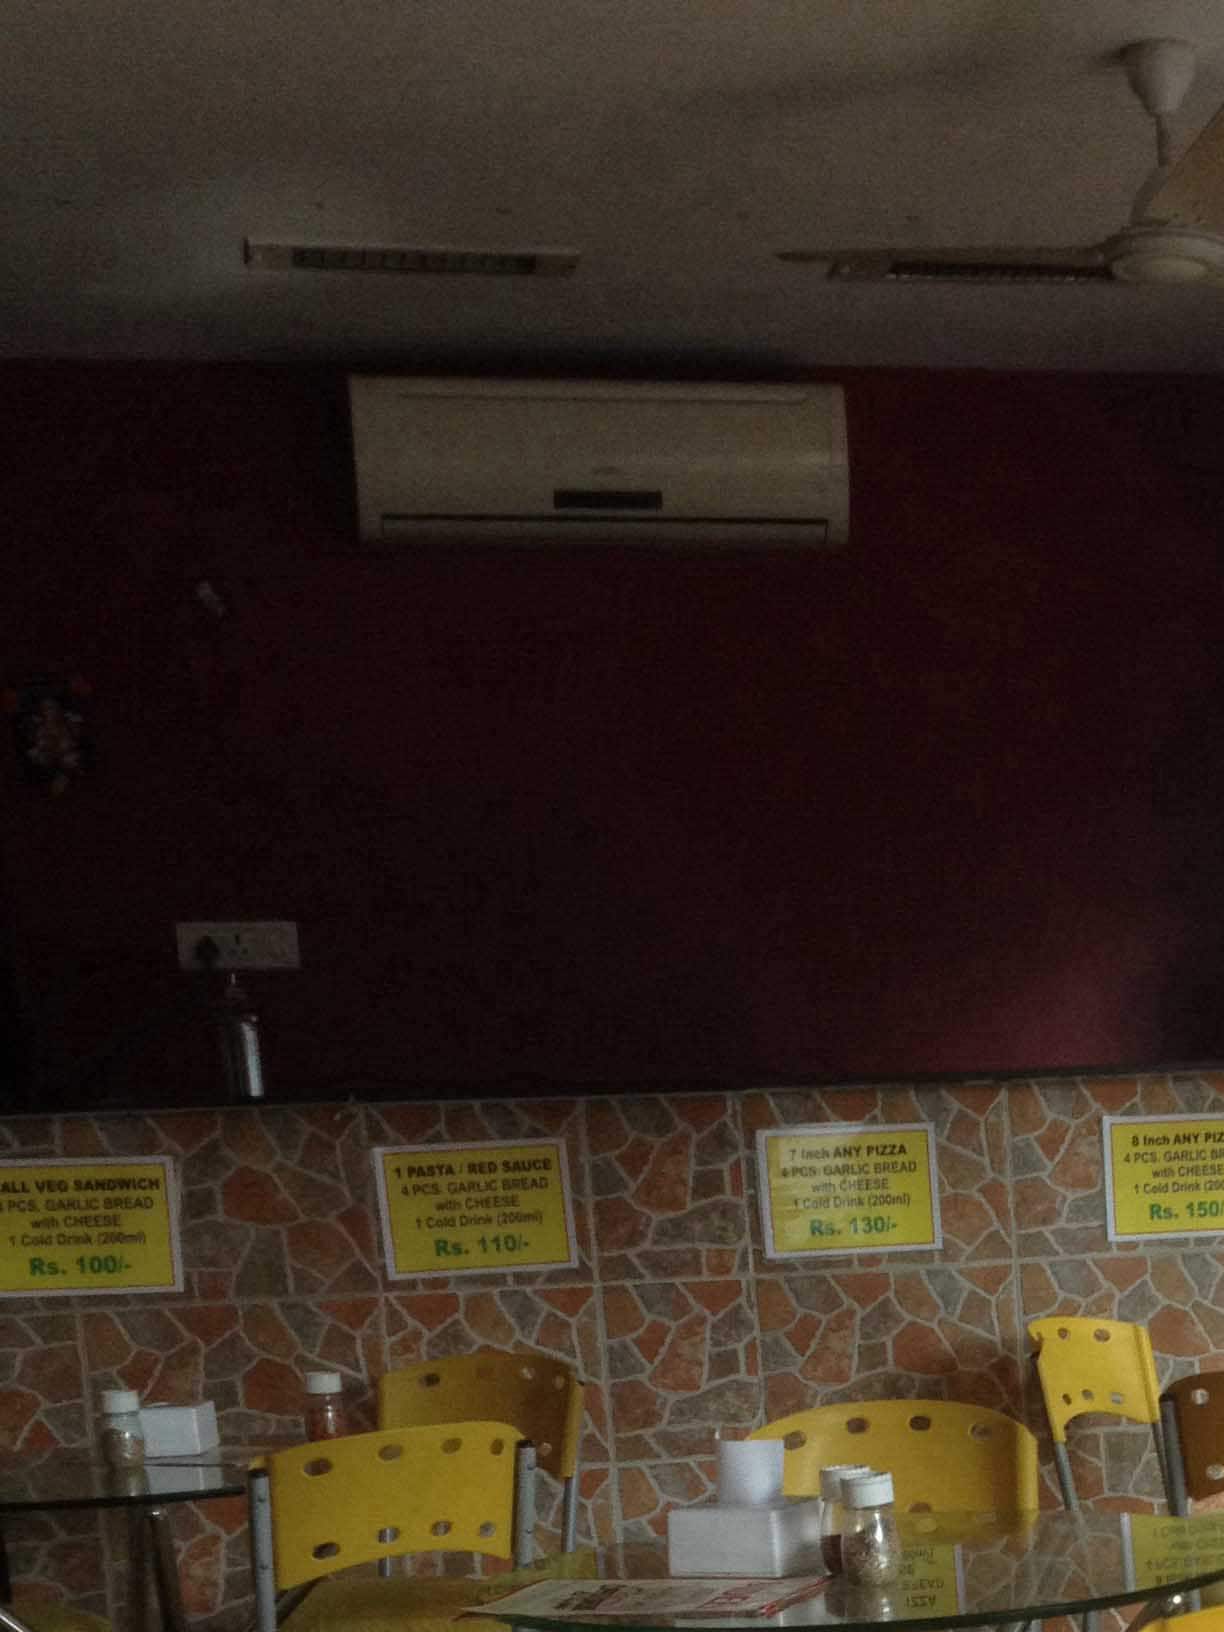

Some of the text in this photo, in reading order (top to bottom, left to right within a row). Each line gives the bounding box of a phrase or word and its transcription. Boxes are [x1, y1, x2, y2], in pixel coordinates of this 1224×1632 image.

[1172, 1132, 1200, 1144] ANY
[833, 1145, 862, 1158] ANY
[867, 1144, 907, 1157] PIZZA
[1163, 1149, 1207, 1162] GARLIC
[408, 1165, 455, 1178] PASTA
[468, 1161, 497, 1175] RED
[503, 1158, 552, 1172] SAUCE
[823, 1163, 869, 1175] GARLIC
[874, 1161, 917, 1174] BREAD
[1152, 1164, 1224, 1178] with CHEESE
[73, 1178, 160, 1191] SANDWICH
[448, 1180, 498, 1195] GARLIC
[502, 1177, 549, 1191] BREAD
[811, 1178, 889, 1193] with CHEESE
[1143, 1181, 1169, 1194] Cold
[1171, 1180, 1201, 1192] Drink
[46, 1199, 99, 1211] GARLIC
[104, 1196, 153, 1210] BREAD
[435, 1195, 520, 1211] with CHEESE
[803, 1197, 830, 1210] Cold
[833, 1196, 865, 1208] Drink
[1150, 1203, 1179, 1221] Rs.
[32, 1215, 120, 1228] with CHEESE
[426, 1216, 456, 1229] Cold
[460, 1214, 493, 1227] Drink
[810, 1215, 898, 1237] Rs. 130/-
[21, 1234, 52, 1246] Cold
[57, 1233, 92, 1245] Drink
[434, 1239, 470, 1257] Rs.
[30, 1257, 67, 1276] Rs.
